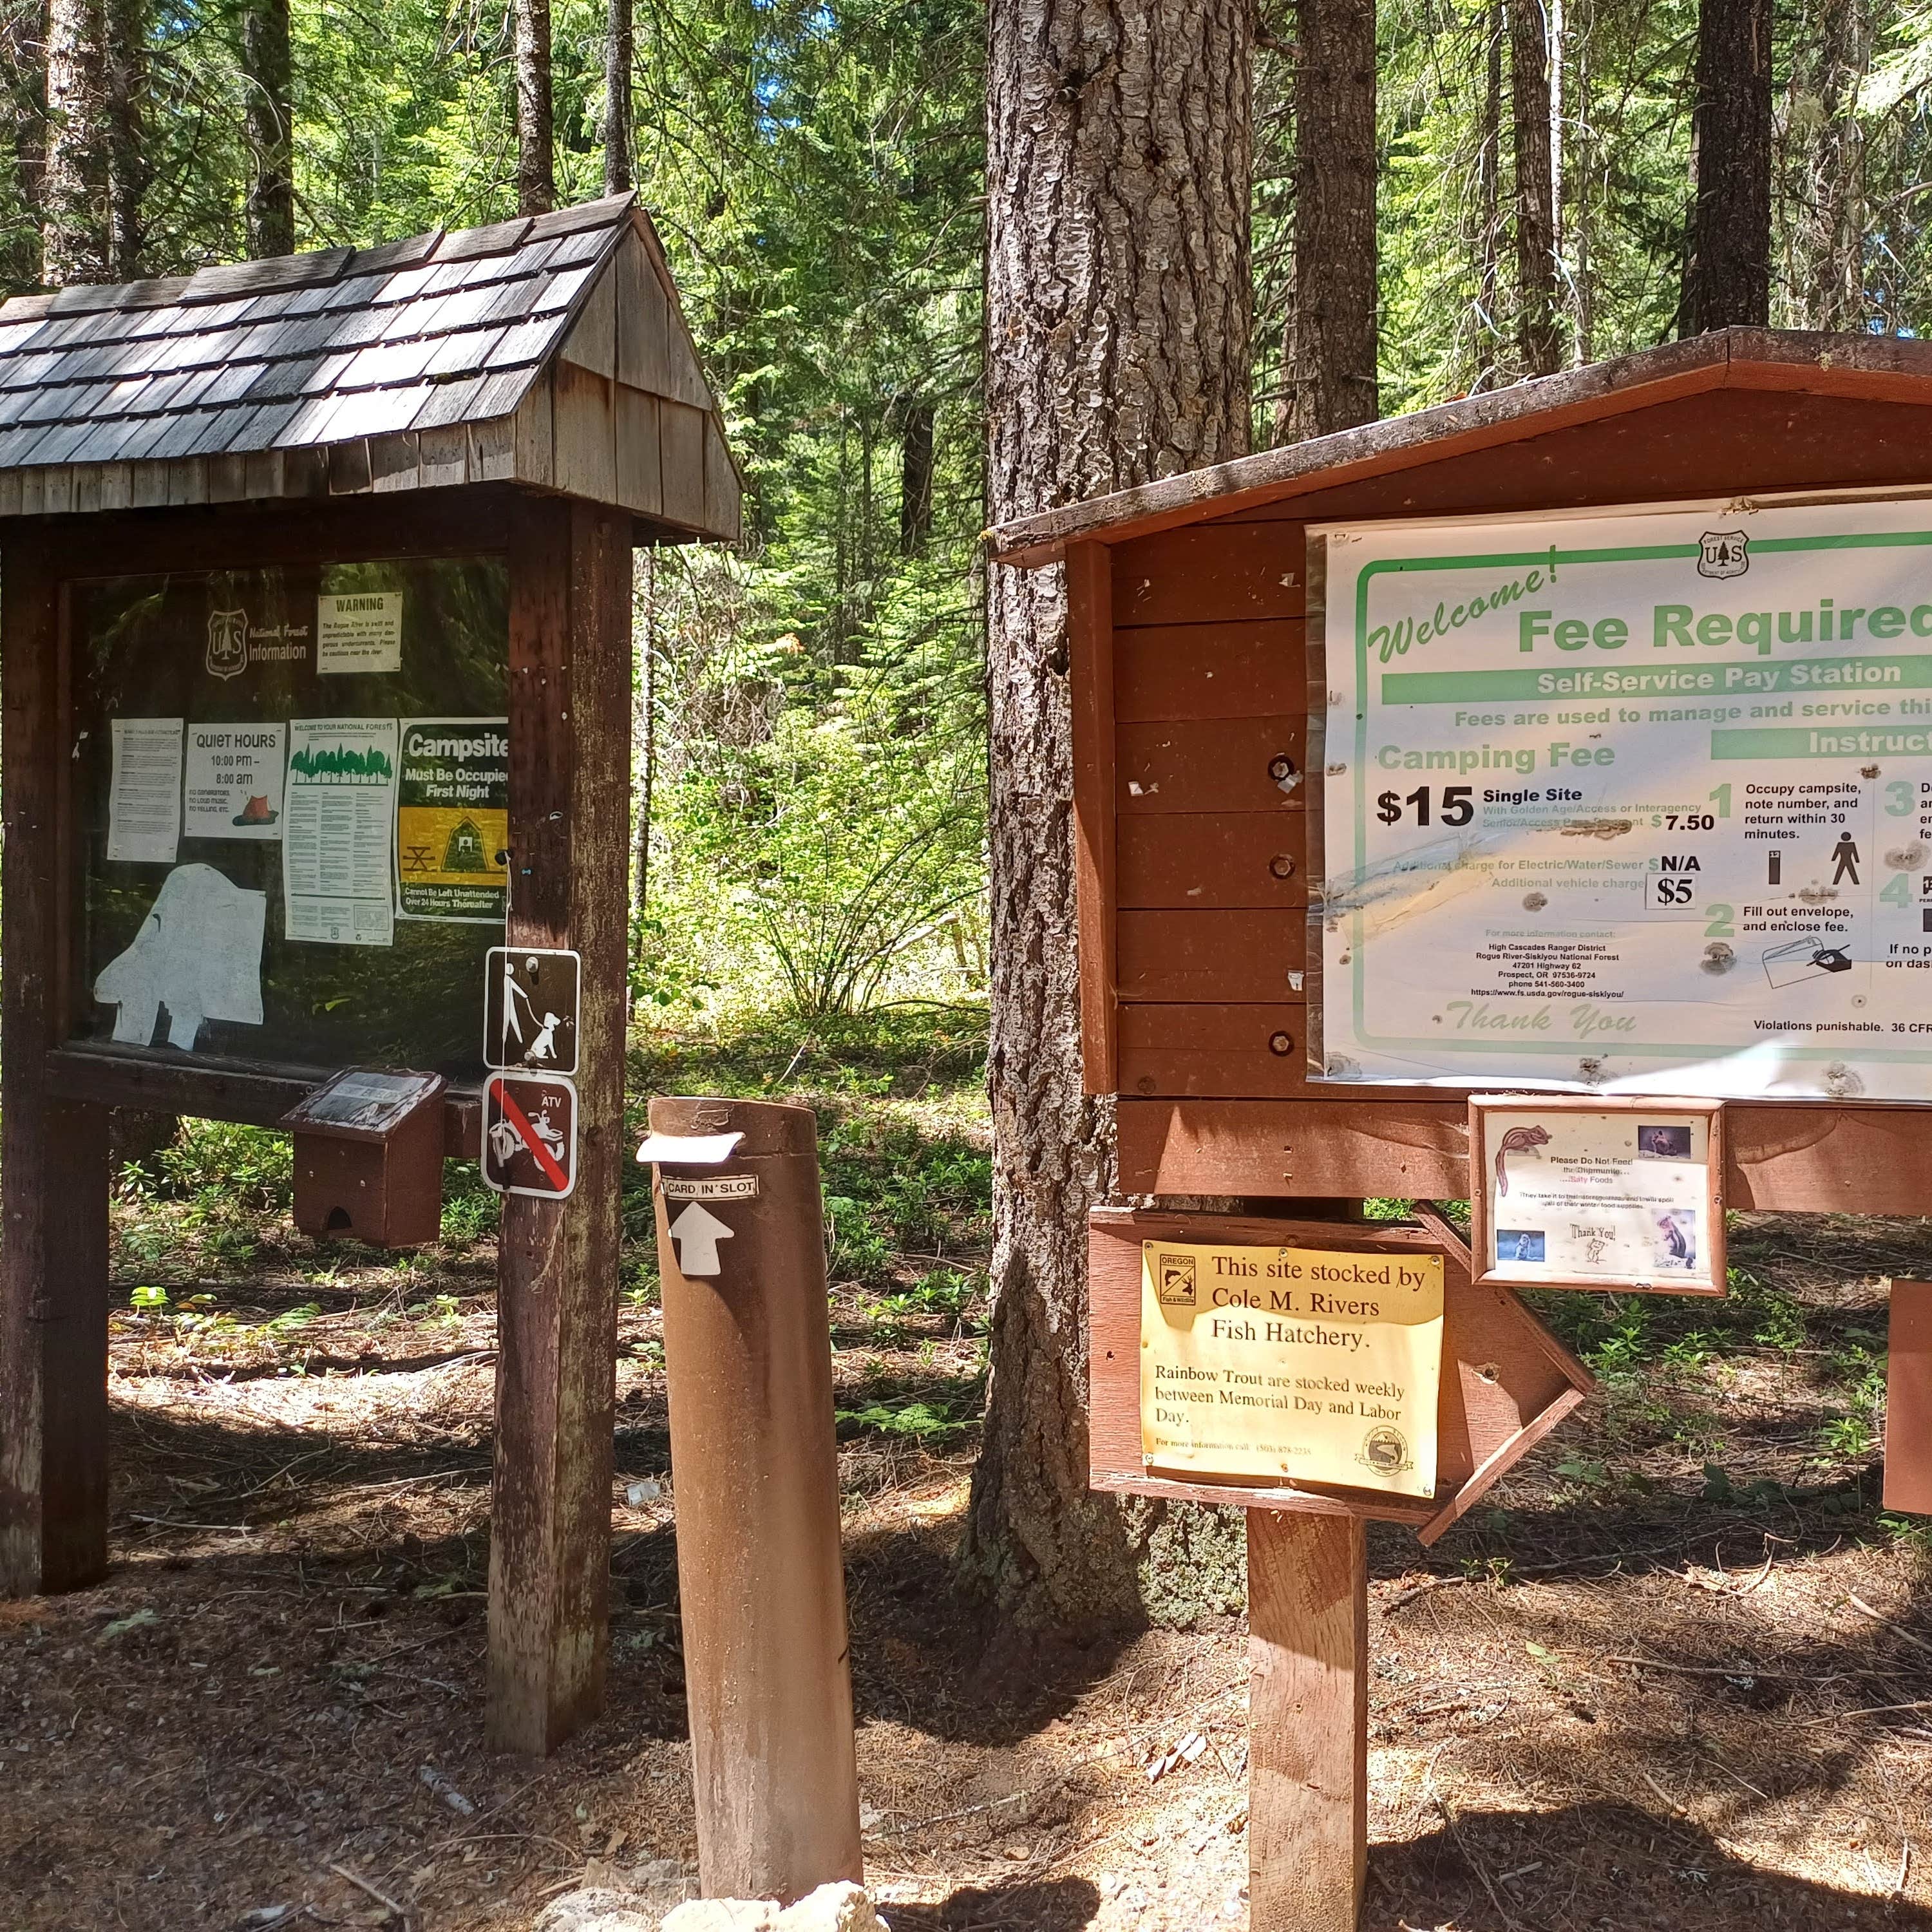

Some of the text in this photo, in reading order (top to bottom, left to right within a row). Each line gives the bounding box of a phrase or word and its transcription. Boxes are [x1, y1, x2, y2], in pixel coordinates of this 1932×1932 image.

[336, 598, 384, 612] WARNING
[1367, 544, 1557, 663] Welcome!
[1519, 611, 1628, 652] Fee
[249, 642, 307, 661] Information
[1537, 662, 1901, 694] Self-Service Pay Station
[1455, 698, 1932, 726] Fees are used to manage and service thi
[234, 734, 276, 748] HOURS
[1809, 730, 1932, 753] Instruc
[211, 755, 233, 766] 10:00
[1378, 742, 1615, 775] Camping Fee
[216, 773, 234, 784] 8:00
[405, 768, 507, 784] Must Be Occupie
[426, 784, 489, 800] First Night
[1483, 788, 1582, 805] Single Site
[1746, 782, 1861, 796] Occupy campsite,
[1376, 786, 1474, 827] $15
[1709, 783, 1732, 818] 1
[1745, 798, 1858, 810] note number, and
[1884, 781, 1915, 817] 3
[1483, 806, 1507, 815] With
[1510, 805, 1549, 815] Golden
[1553, 804, 1616, 815] Age/Access
[1635, 804, 1701, 815] Interagency
[1665, 815, 1714, 830] 7.50
[1745, 813, 1845, 824] return within 30
[1745, 829, 1799, 838] minutes.
[1499, 860, 1515, 869] for
[1519, 860, 1643, 869] Electric/Water/Sewer
[1662, 856, 1701, 871] N/A
[1492, 878, 1645, 890] Additional vehicle charge
[1658, 877, 1692, 905] $5
[1879, 873, 1913, 908] 4
[405, 887, 427, 896] Cannot
[438, 889, 453, 897] Left
[454, 889, 499, 899] Unattended
[406, 897, 419, 905] Over
[430, 898, 450, 907] Hours
[452, 899, 493, 909] Thereafter
[1705, 904, 1735, 937] 2
[1743, 907, 1853, 919] Fill out envelope,
[1527, 929, 1577, 938] information
[1580, 930, 1615, 938] contact:
[1743, 922, 1848, 932] and enclose fee.
[1890, 943, 1899, 954] If
[1902, 946, 1918, 954] no
[1502, 952, 1558, 961] River-Siskiyou
[1907, 960, 1932, 969] das
[1446, 1001, 1637, 1039] Thank You
[1754, 1020, 1932, 1033] Violations punishable. 36 CFR
[541, 1096, 562, 1108] ATV
[1550, 1156, 1578, 1164] Please
[668, 1183, 696, 1193] CARD
[702, 1185, 714, 1194] IN
[720, 1182, 753, 1193] SLOT
[1569, 1224, 1596, 1240] Thank
[1162, 1256, 1193, 1265] OREGON
[1212, 1256, 1425, 1292] This site stocked by
[1212, 1287, 1379, 1316] Cole M. Rivers
[1211, 1318, 1369, 1352] Fish Hatchery.
[1155, 1365, 1405, 1401] Rainbow Trout are stocked weekly
[1155, 1386, 1401, 1421] between Memorial Day and Labor
[1155, 1408, 1189, 1426] Day.
[1156, 1437, 1168, 1446] For
